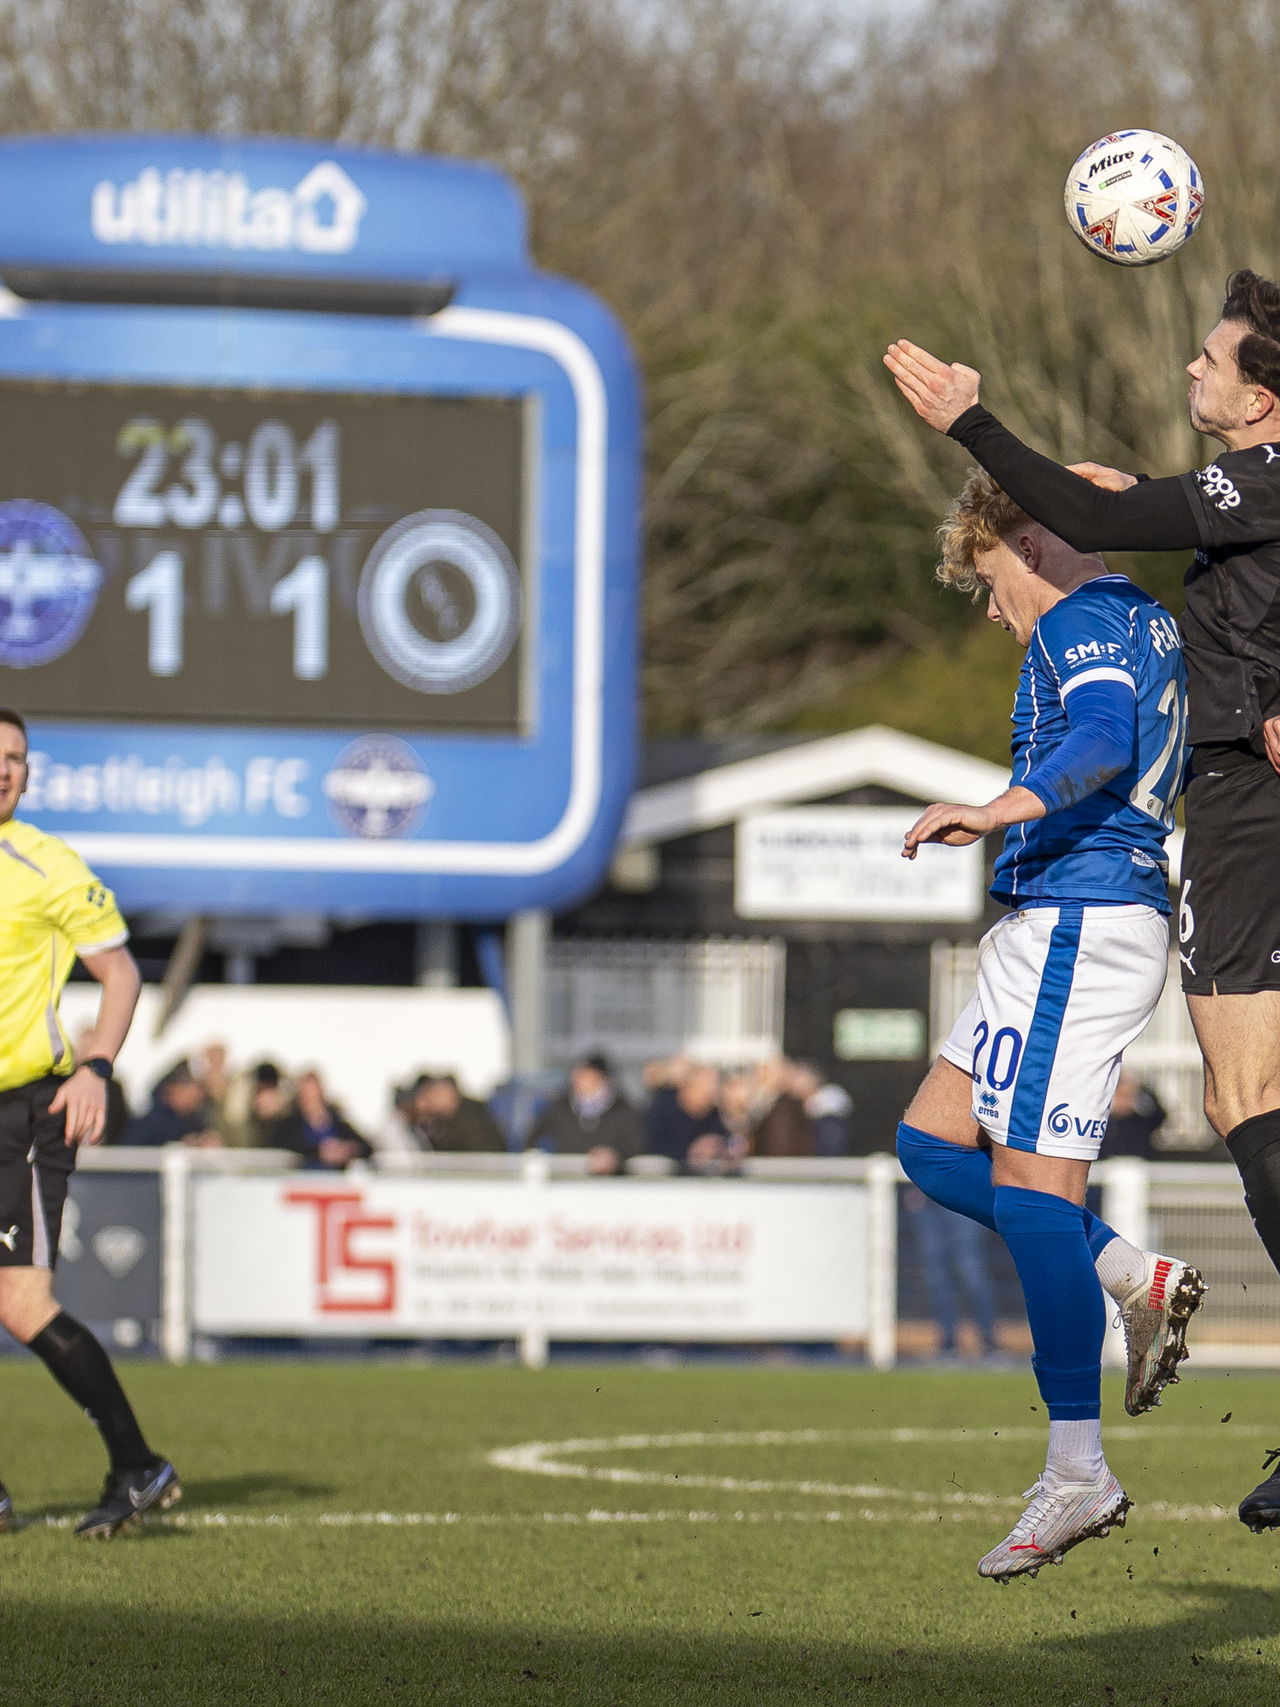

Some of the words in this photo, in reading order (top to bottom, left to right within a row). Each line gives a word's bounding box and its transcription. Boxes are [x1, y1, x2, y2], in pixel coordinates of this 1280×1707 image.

[1087, 150, 1135, 179] Mitre
[91, 166, 299, 251] utilita
[113, 417, 342, 532] 23:01
[126, 550, 184, 677] 1
[271, 555, 330, 681] 1
[25, 751, 241, 828] Eastleigh
[245, 757, 312, 820] FC
[1179, 879, 1195, 943] 6
[973, 1020, 1023, 1091] 20
[978, 1105, 999, 1119] errea
